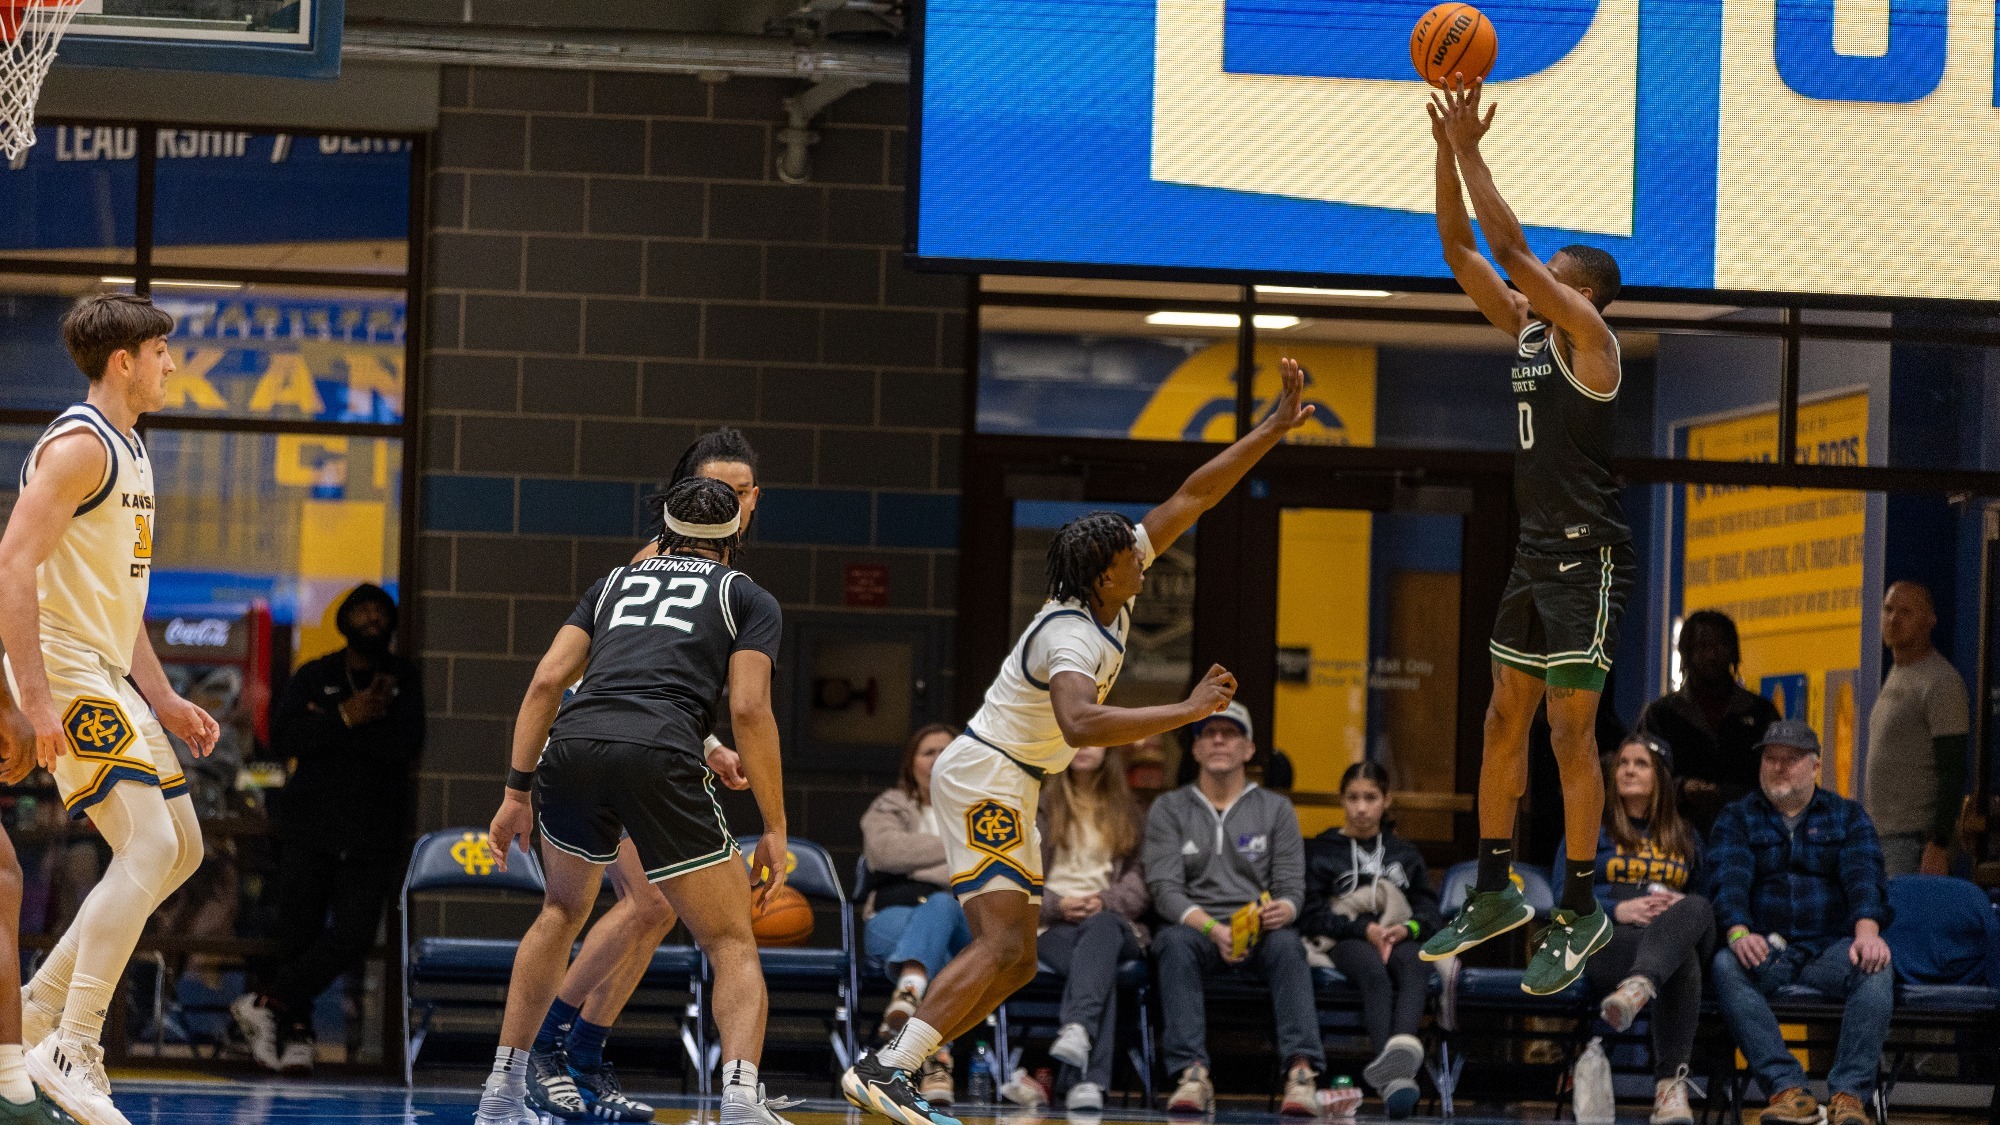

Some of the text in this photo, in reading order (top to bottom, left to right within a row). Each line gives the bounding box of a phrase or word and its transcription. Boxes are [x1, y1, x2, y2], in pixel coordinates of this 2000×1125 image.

[1432, 14, 1473, 66] Wilson
[1517, 401, 1535, 450] 0
[631, 559, 716, 576] JOHNSON
[608, 575, 709, 634] 22
